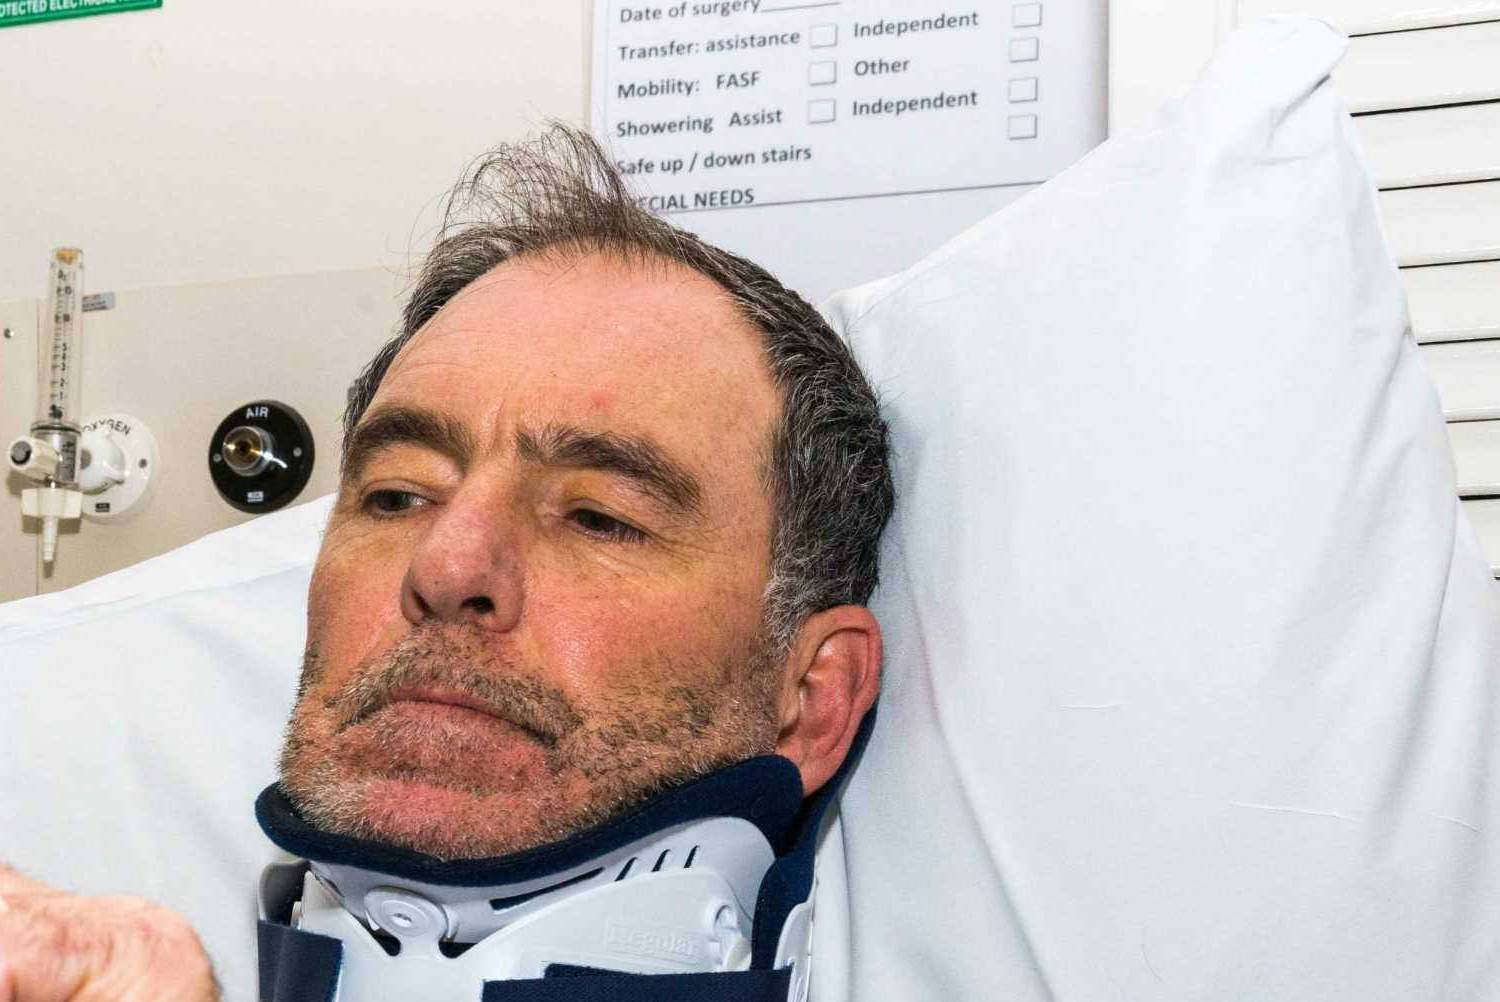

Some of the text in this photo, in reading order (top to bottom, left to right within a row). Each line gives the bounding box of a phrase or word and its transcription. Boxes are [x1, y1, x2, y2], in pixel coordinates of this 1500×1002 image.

[620, 0, 761, 23] Date of surgery
[618, 12, 979, 61] Transfer: assistance Independent
[617, 58, 911, 99] Mobility: FASF Other
[616, 91, 978, 138] Showering Assist Independent
[617, 145, 812, 175] Safe up / down stairs
[638, 188, 755, 211] ECIAL NEEDS
[246, 406, 269, 419] AIR
[610, 926, 699, 957] Regular
